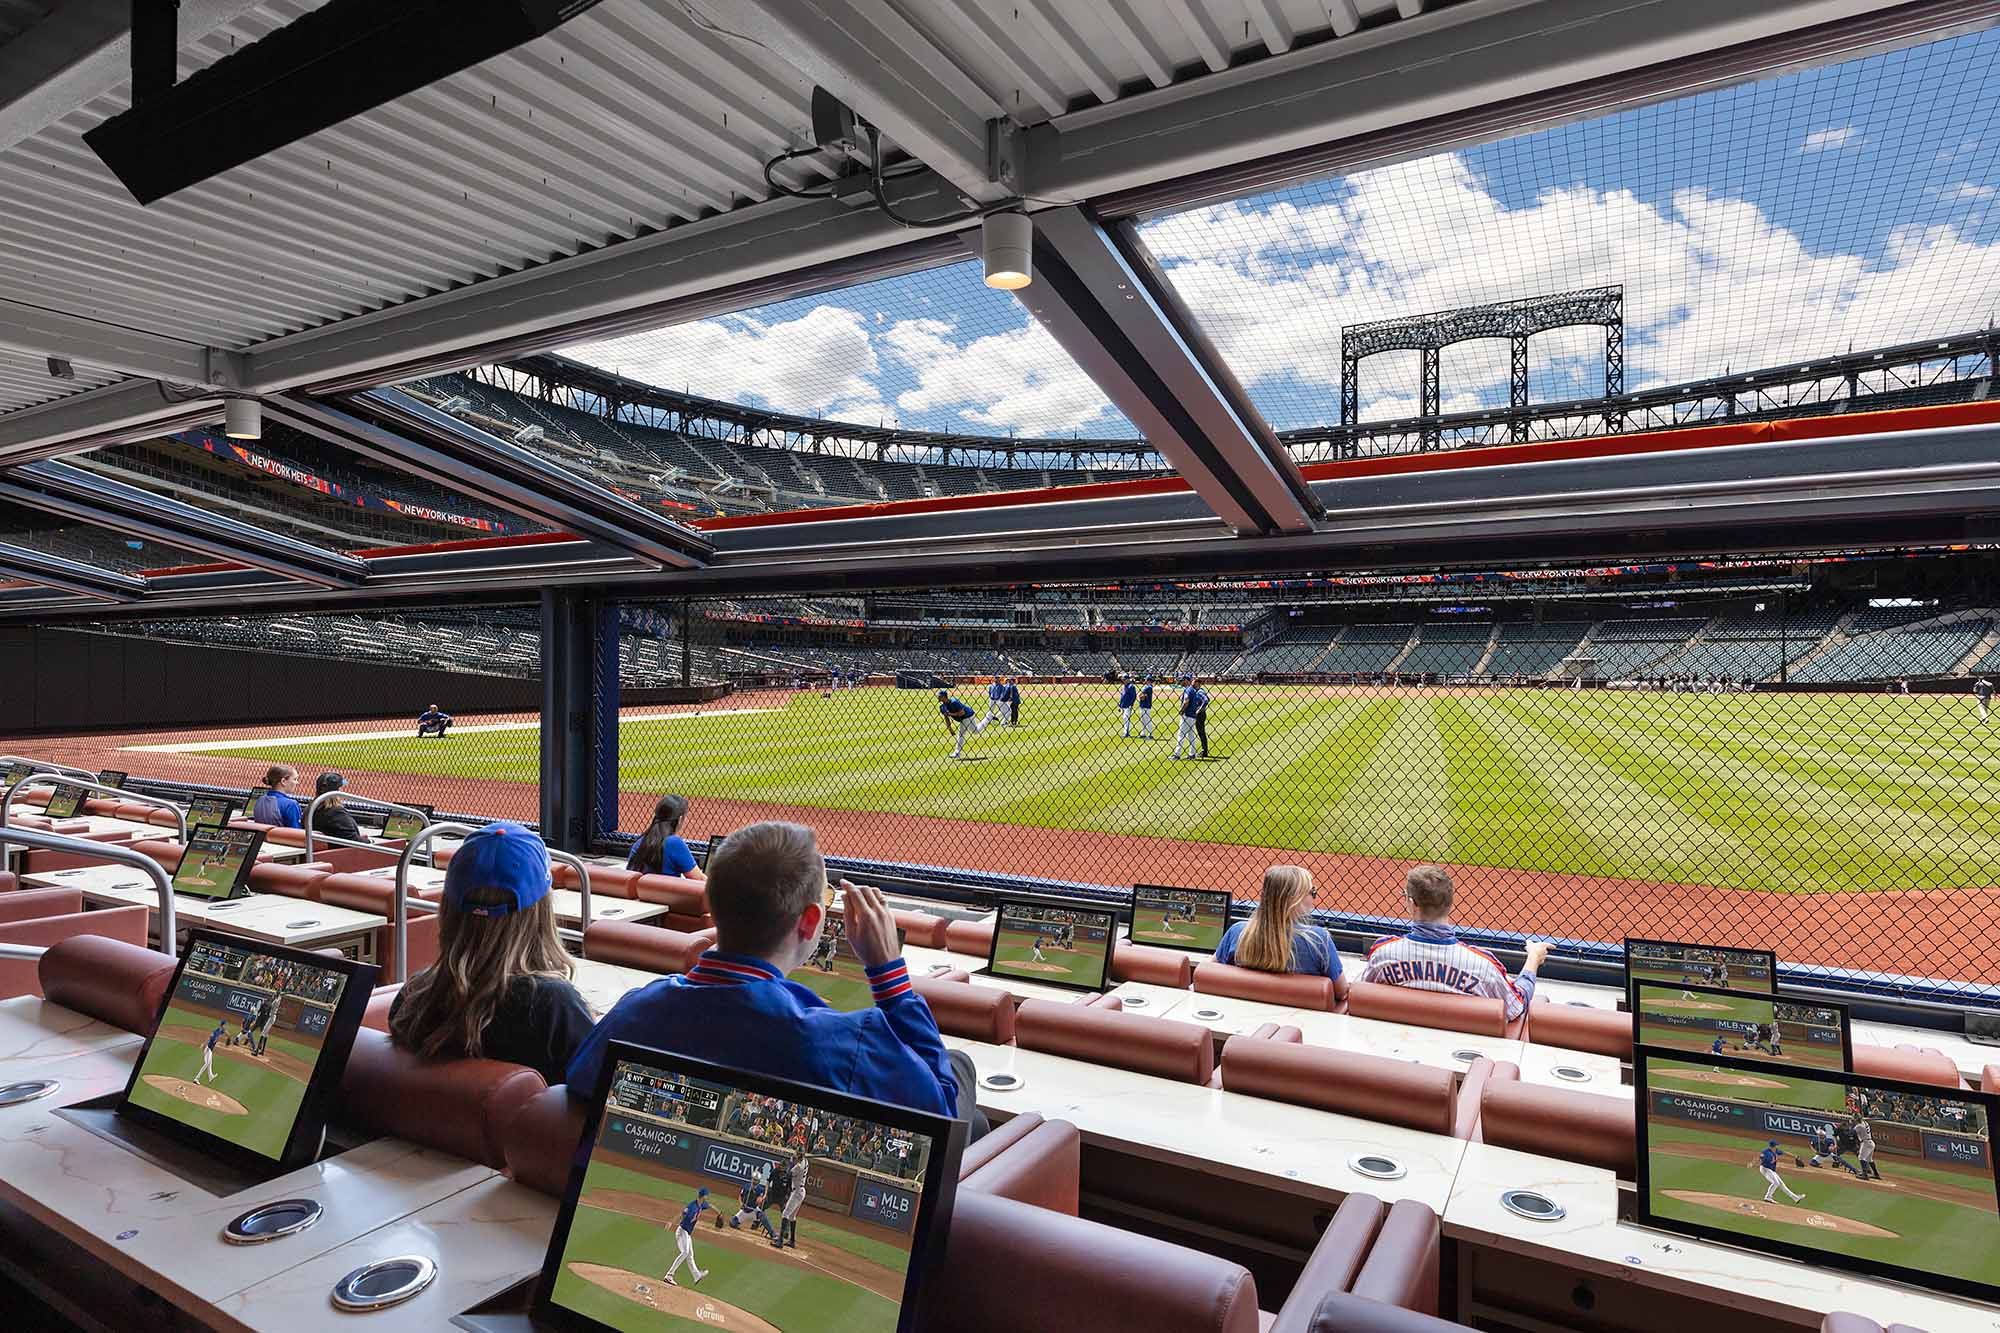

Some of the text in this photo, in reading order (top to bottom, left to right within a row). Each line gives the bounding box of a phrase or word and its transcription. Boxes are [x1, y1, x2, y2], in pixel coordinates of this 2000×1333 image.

[251, 454, 308, 486] NEW YORK METS
[404, 504, 466, 526] NEW YORK METS
[1382, 960, 1480, 994] HERNANDEZ
[311, 1013, 328, 1025] MLB
[632, 1074, 644, 1083] NYY
[662, 1082, 676, 1091] NYM
[680, 1086, 686, 1094] 0
[1673, 1098, 1730, 1114] CASAMIGOS
[1687, 1108, 1717, 1120] Tequila
[624, 1122, 677, 1146] CASAMIGOS
[633, 1138, 662, 1155] Tequila
[1950, 1142, 1979, 1155] MLB
[1952, 1152, 1972, 1161] App
[880, 1192, 910, 1213] MLB
[880, 1207, 898, 1220] App
[695, 1306, 726, 1323] Corona
